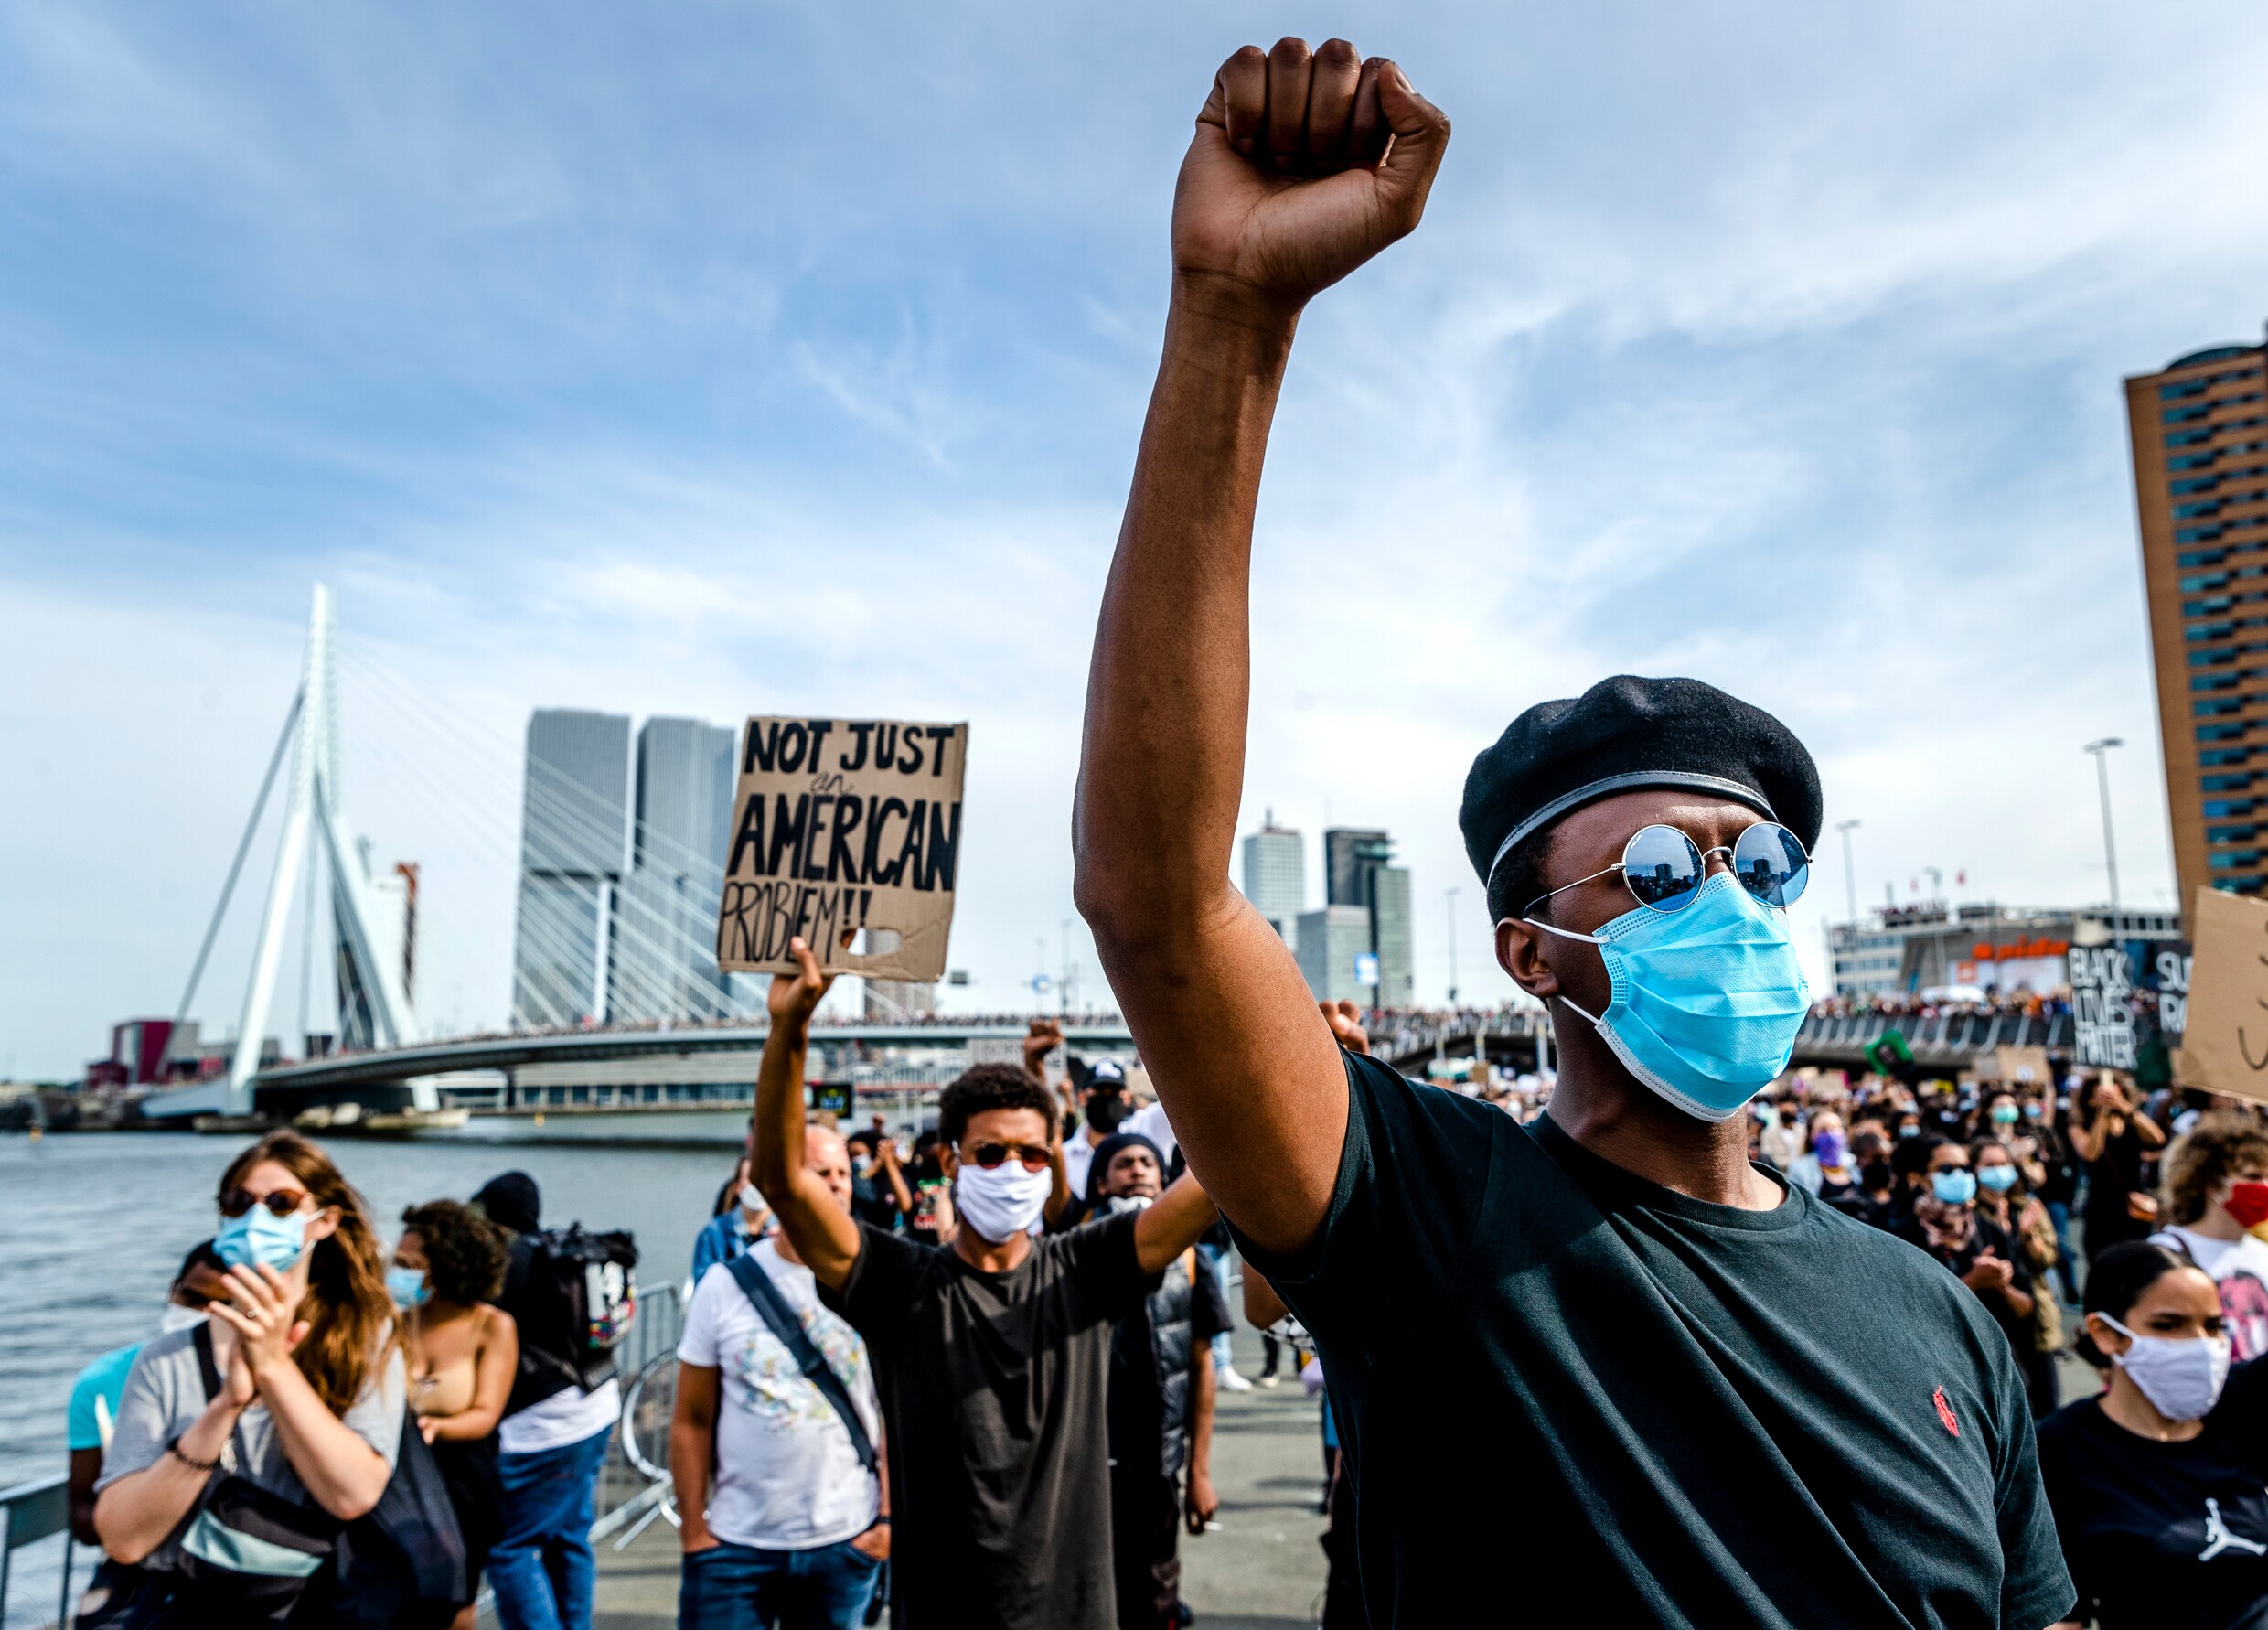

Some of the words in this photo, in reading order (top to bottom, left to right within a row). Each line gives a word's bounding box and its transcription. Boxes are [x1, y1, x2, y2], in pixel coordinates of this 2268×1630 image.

[744, 720, 832, 774] NOT
[840, 723, 954, 777] JUST
[726, 792, 960, 892] AMERICAN
[2068, 947, 2131, 991] BLACK
[2072, 987, 2134, 1031] LIVES
[2076, 1026, 2139, 1069] MATTER
